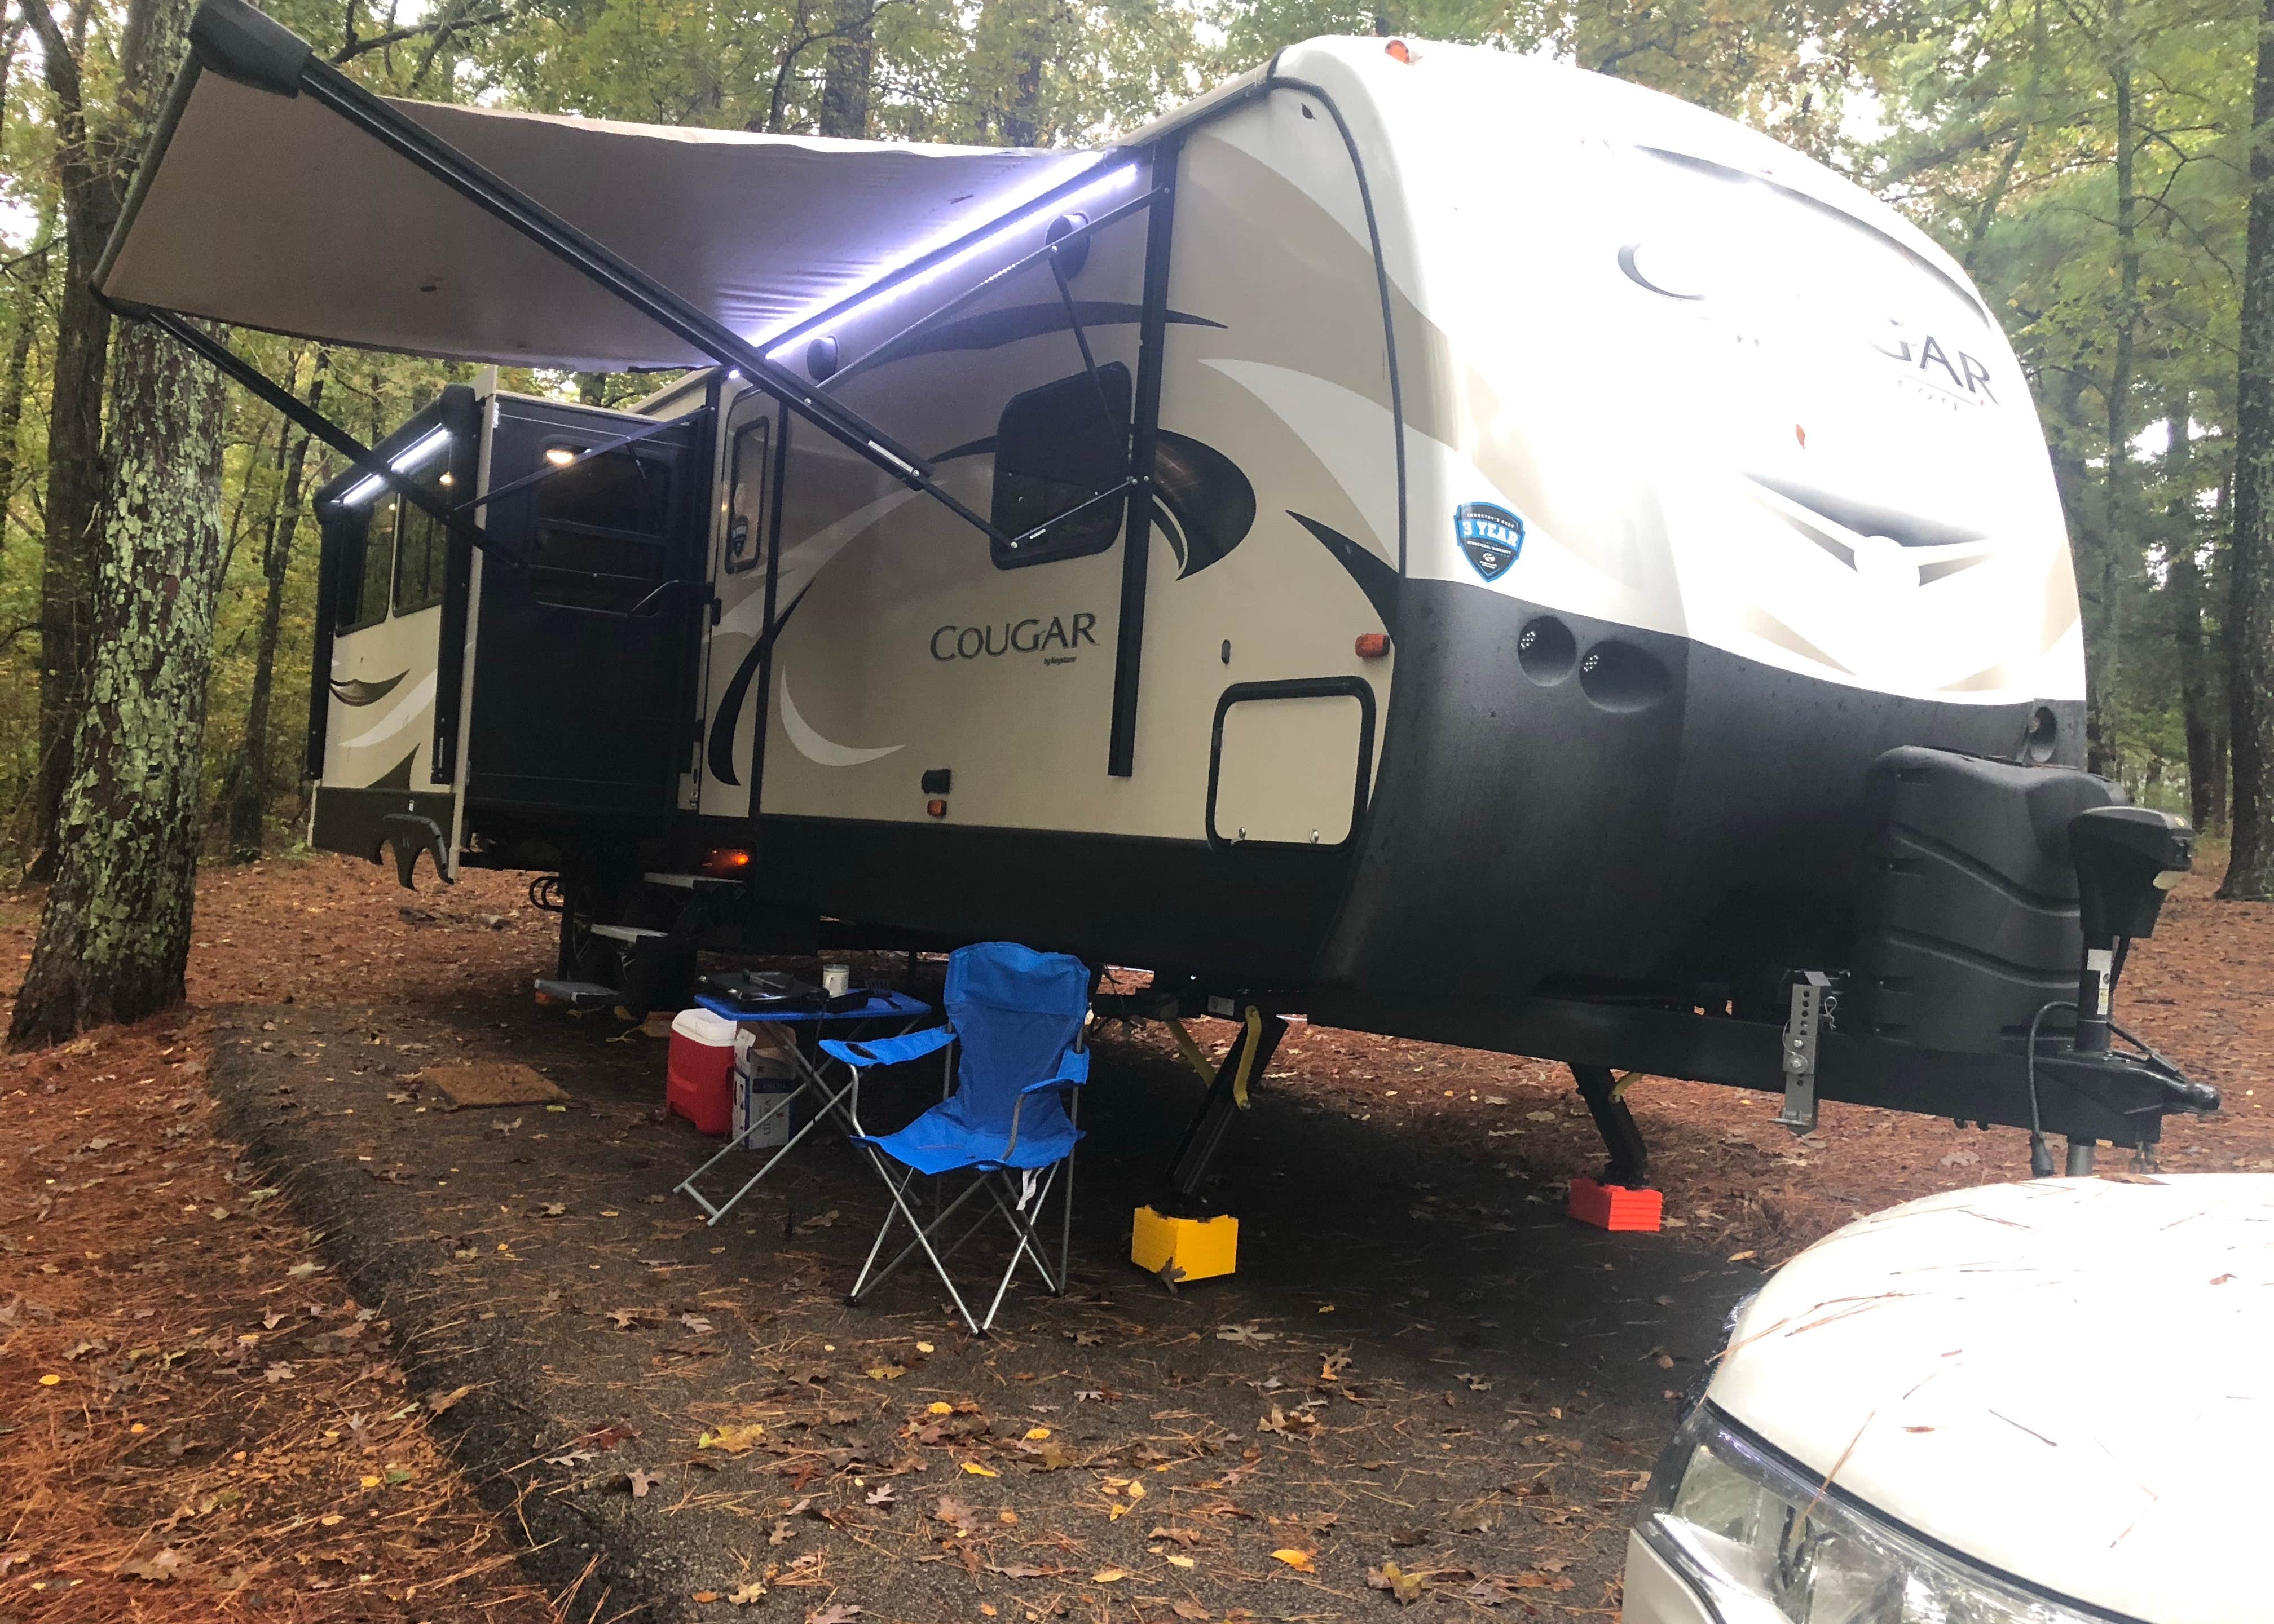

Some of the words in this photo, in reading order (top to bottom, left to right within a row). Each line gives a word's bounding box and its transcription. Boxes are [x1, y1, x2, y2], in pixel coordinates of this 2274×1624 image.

[1462, 521, 1473, 536] 3
[1477, 521, 1518, 547] YEAR
[931, 613, 1100, 662] COUGAR
